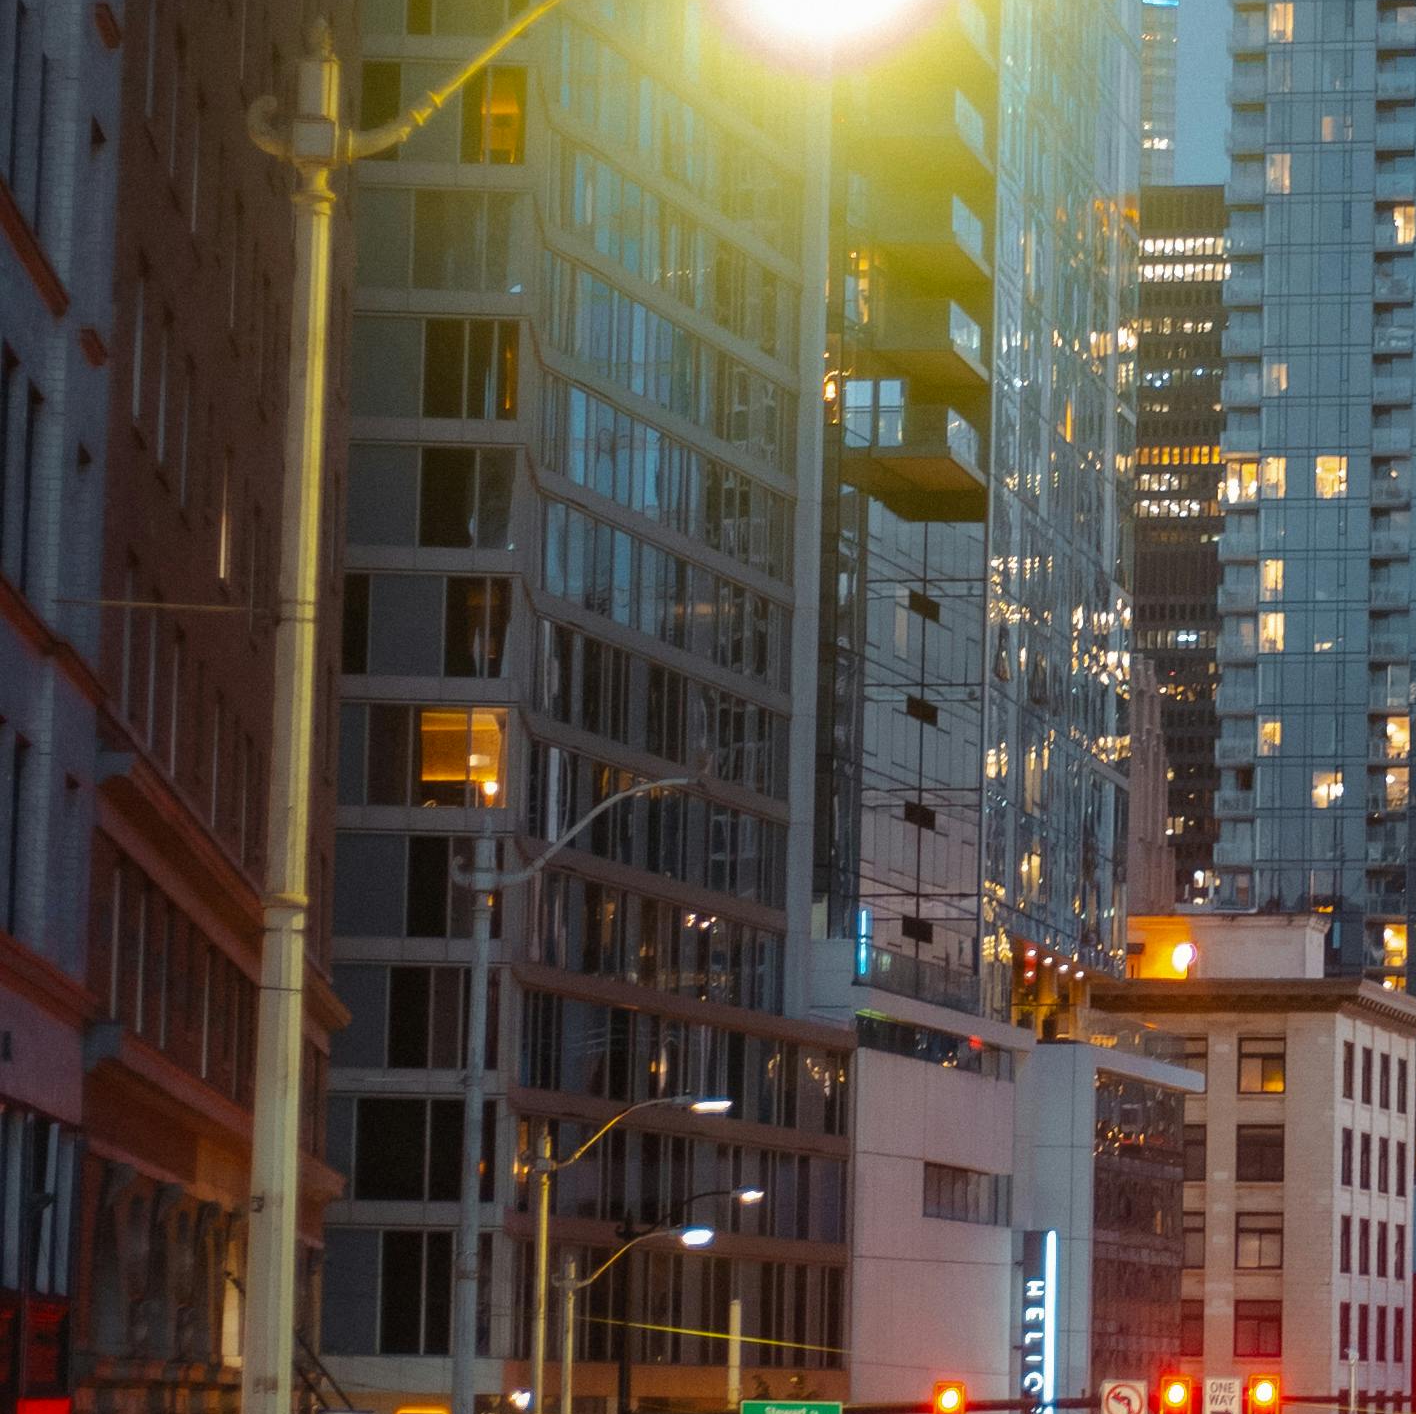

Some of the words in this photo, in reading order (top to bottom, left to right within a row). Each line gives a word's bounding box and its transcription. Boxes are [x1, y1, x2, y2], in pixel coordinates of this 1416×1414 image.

[1024, 1280, 1045, 1414] HELIO
[1210, 1381, 1235, 1394] ONE
[1209, 1394, 1235, 1406] WAY
